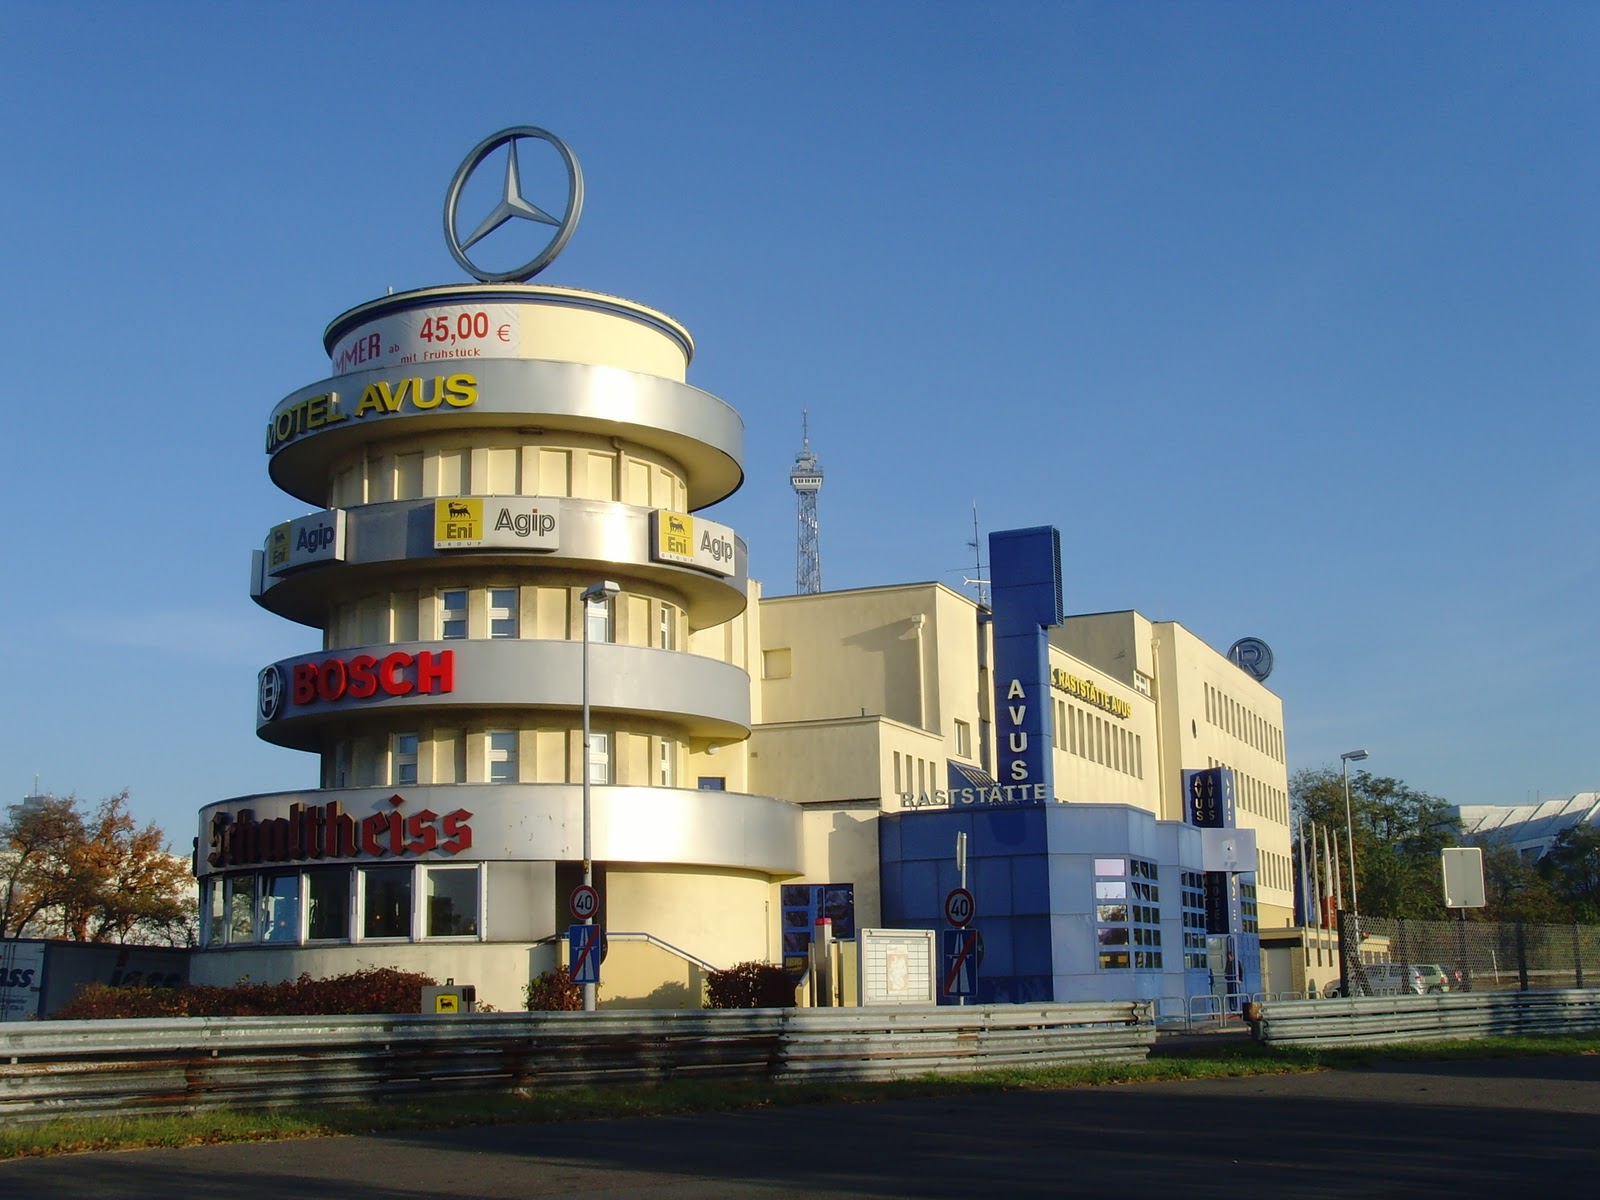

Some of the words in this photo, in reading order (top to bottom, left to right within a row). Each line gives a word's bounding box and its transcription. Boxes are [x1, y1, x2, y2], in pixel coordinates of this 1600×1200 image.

[389, 343, 400, 353] ab
[420, 312, 489, 346] 45,00
[497, 324, 511, 342] €
[400, 352, 417, 364] mit
[265, 391, 346, 454] MOTEL
[354, 373, 479, 417] AVUS
[447, 523, 473, 539] Eni
[494, 508, 556, 537] Agip
[296, 522, 335, 553] Agip
[668, 536, 687, 554] Eni
[700, 530, 733, 563] Agip
[292, 650, 455, 706] BOSCH
[1110, 695, 1133, 719] AVUS
[1007, 679, 1029, 781] AVUS
[900, 782, 1047, 808] RASTSTÄTTE
[1194, 775, 1204, 821] AVUS
[576, 894, 593, 910] 40
[951, 899, 969, 916] 40
